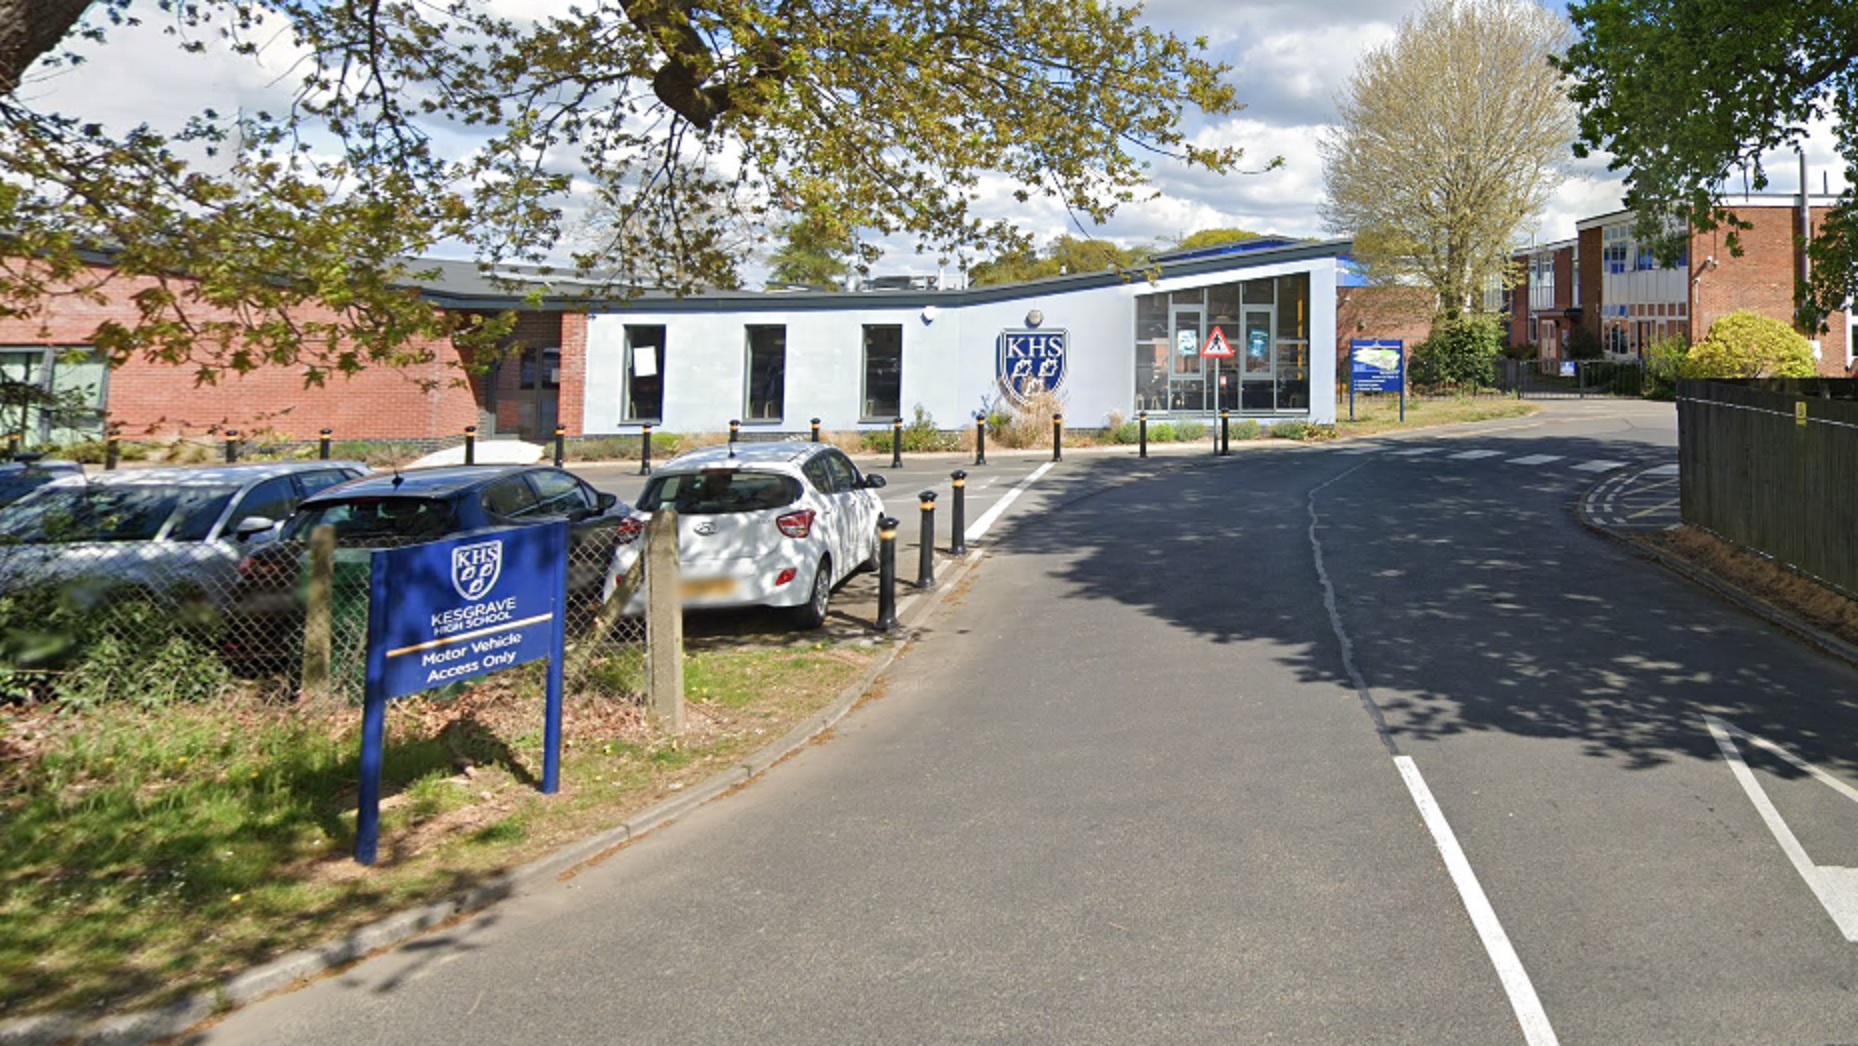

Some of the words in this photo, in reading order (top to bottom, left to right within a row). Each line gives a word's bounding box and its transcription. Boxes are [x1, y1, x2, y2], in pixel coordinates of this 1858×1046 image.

[1006, 337, 1063, 358] KHS
[457, 547, 498, 568] KHS
[431, 597, 516, 627] KESGRAVE
[433, 621, 463, 636] HIGH
[466, 611, 513, 629] SCHOOL
[422, 646, 467, 667] Motor
[472, 632, 522, 654] Vehicle
[427, 662, 479, 683] Access
[483, 651, 516, 669] Only
